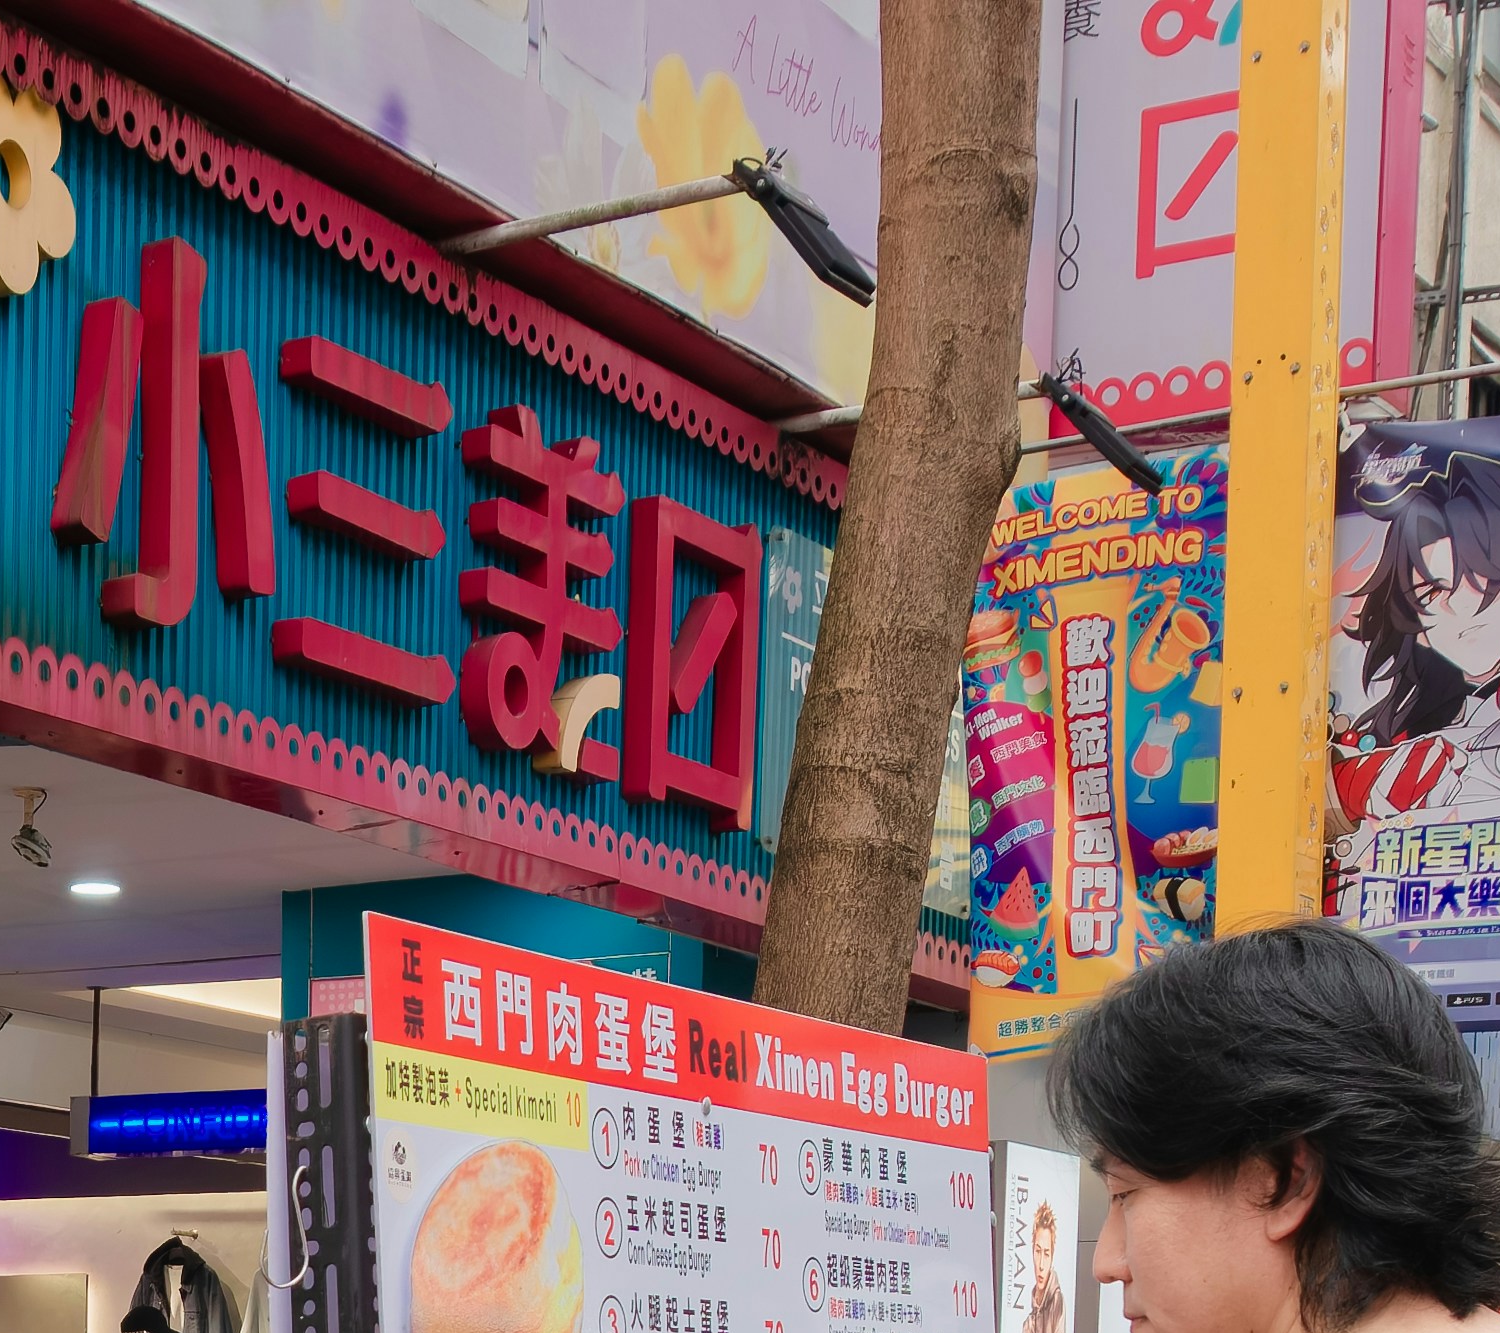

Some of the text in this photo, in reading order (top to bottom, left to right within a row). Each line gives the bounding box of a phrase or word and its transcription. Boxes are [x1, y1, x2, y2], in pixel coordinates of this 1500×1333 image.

[732, 15, 821, 117] A Little
[991, 485, 1202, 548] WELCOME TO
[992, 529, 1204, 599] XIMENDING
[978, 711, 1024, 742] Walker
[992, 774, 1047, 810] 西門文化
[401, 938, 425, 1040] 正宗
[440, 958, 974, 1128] 西門肉蛋堡 Real Ximen Egg Burger
[385, 1057, 581, 1128] 加特製泡菜 Special kimchi 10
[624, 1150, 722, 1195] Pork Chicken Egg Burger
[759, 1143, 779, 1186] 70
[822, 1137, 975, 1211] 豪華肉蛋堡 100
[626, 1195, 781, 1270] 玉米起司蛋堡 70
[627, 1237, 712, 1278] Corn Cheese Egg Burger
[853, 1213, 870, 1242] Burger
[1012, 1175, 1029, 1310] IB-MAN
[826, 1252, 978, 1319] 超級豪華肉蛋堡 110
